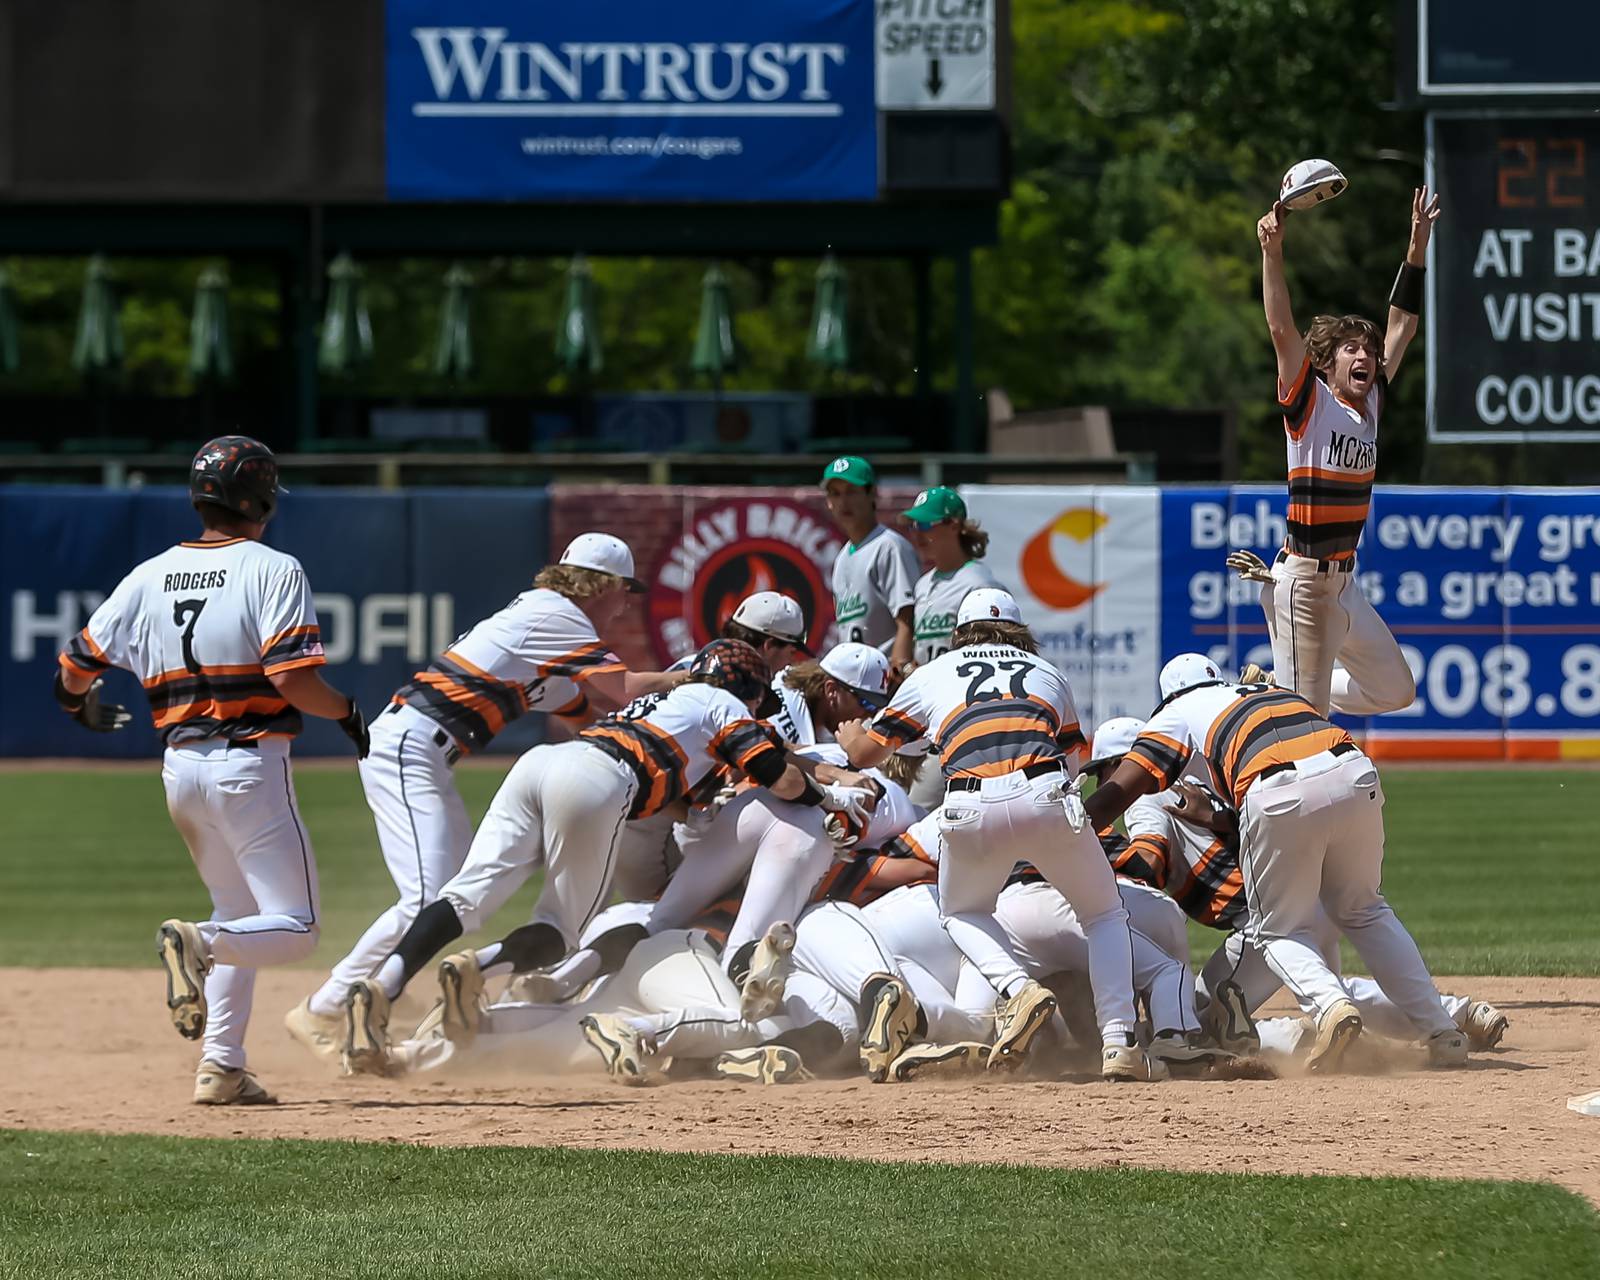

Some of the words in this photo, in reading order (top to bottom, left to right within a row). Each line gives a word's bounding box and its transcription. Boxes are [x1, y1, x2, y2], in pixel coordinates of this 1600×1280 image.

[884, 22, 988, 56] SPEED
[521, 133, 743, 160] wintrust.com/cougars
[1497, 138, 1586, 207] 22
[1473, 229, 1533, 279] AT
[1378, 514, 1524, 563] every
[164, 569, 227, 592] RODGERS
[1396, 571, 1429, 607] a
[1440, 564, 1578, 620] great
[173, 597, 208, 674] 7
[956, 660, 1036, 707] 27
